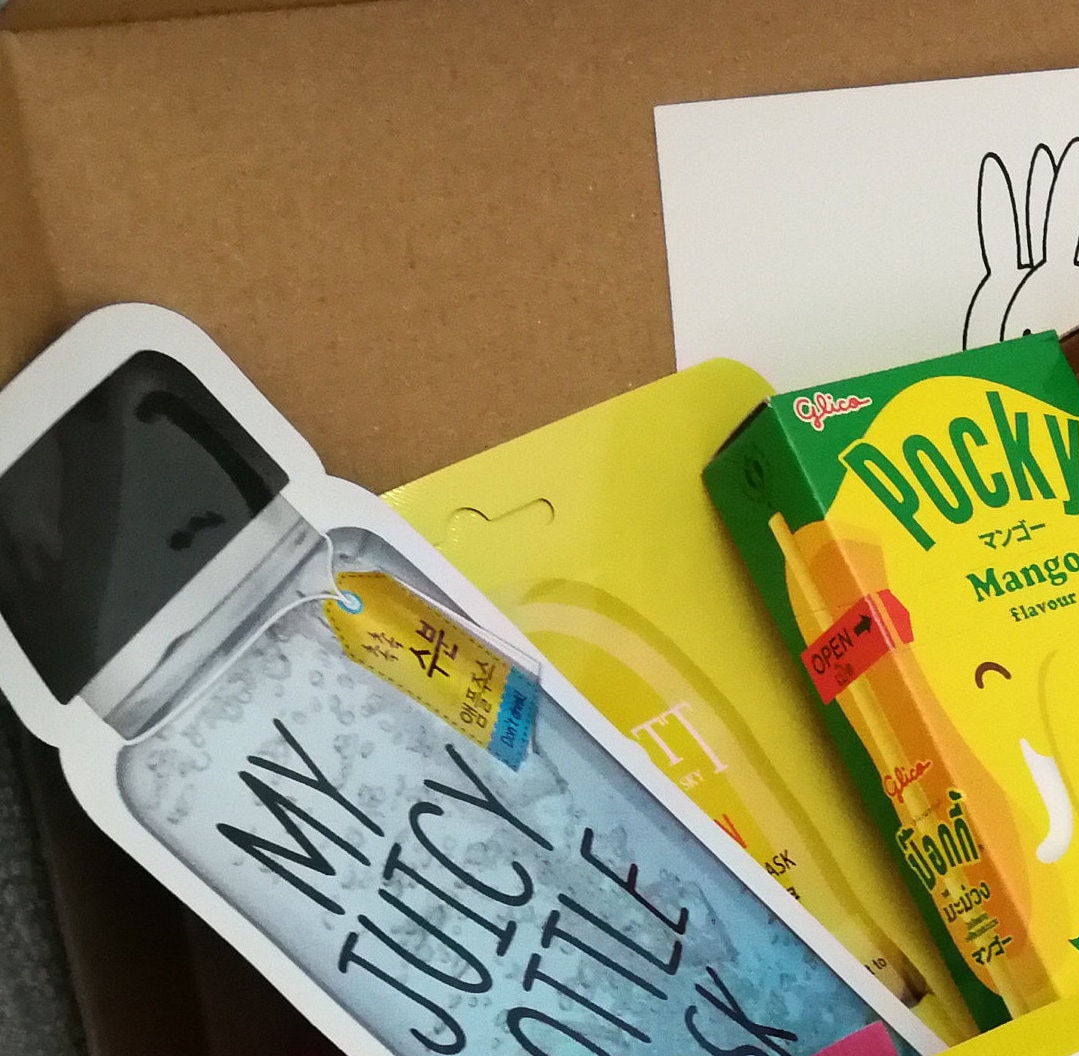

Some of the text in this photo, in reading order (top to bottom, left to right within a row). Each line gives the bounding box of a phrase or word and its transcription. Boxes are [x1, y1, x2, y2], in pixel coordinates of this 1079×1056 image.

[795, 392, 872, 431] Glico
[978, 520, 1046, 550] マンゴー
[1010, 591, 1077, 623] flavour
[408, 619, 459, 678] 수분
[810, 633, 853, 675] OPEN
[883, 760, 931, 803] Glico
[216, 718, 385, 915] MY
[338, 744, 554, 1055] JUICY
